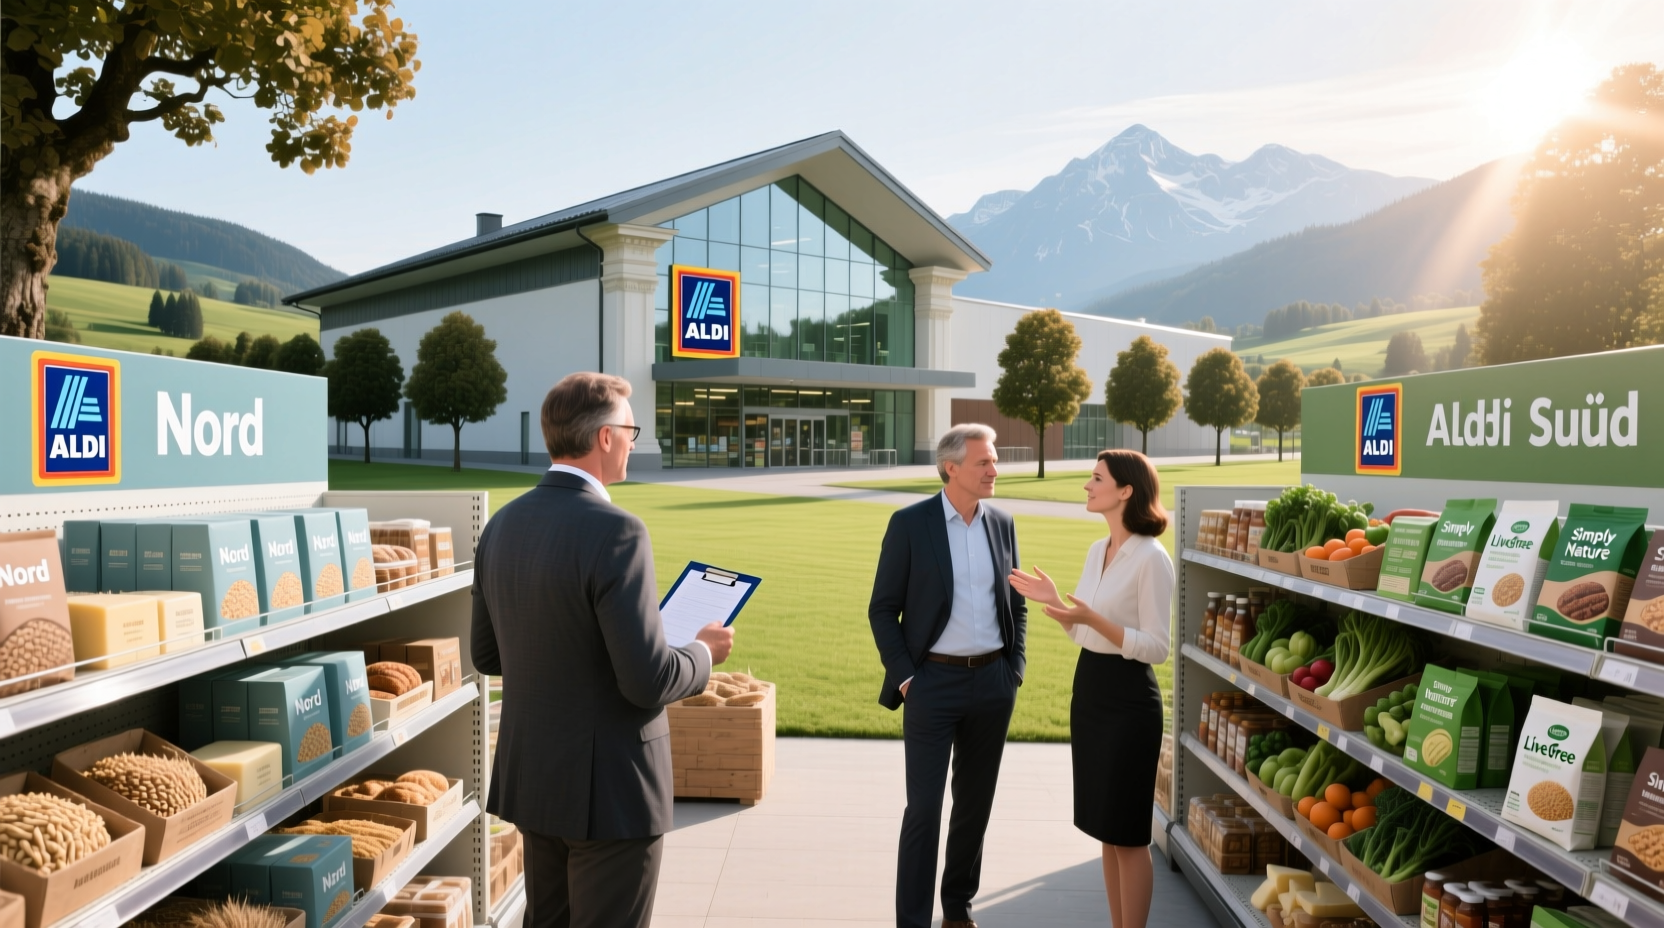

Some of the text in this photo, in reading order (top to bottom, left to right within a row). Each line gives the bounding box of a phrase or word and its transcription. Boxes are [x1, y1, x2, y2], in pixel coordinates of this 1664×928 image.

[685, 322, 729, 341] ALDI
[156, 391, 264, 456] Nord
[49, 434, 106, 459] ALDI
[1363, 439, 1394, 457] ALDI
[1571, 527, 1617, 546] Simply
[219, 543, 250, 565] Nord
[1564, 541, 1611, 560] Nature
[0, 558, 50, 588] Nord
[294, 688, 322, 716] Nord
